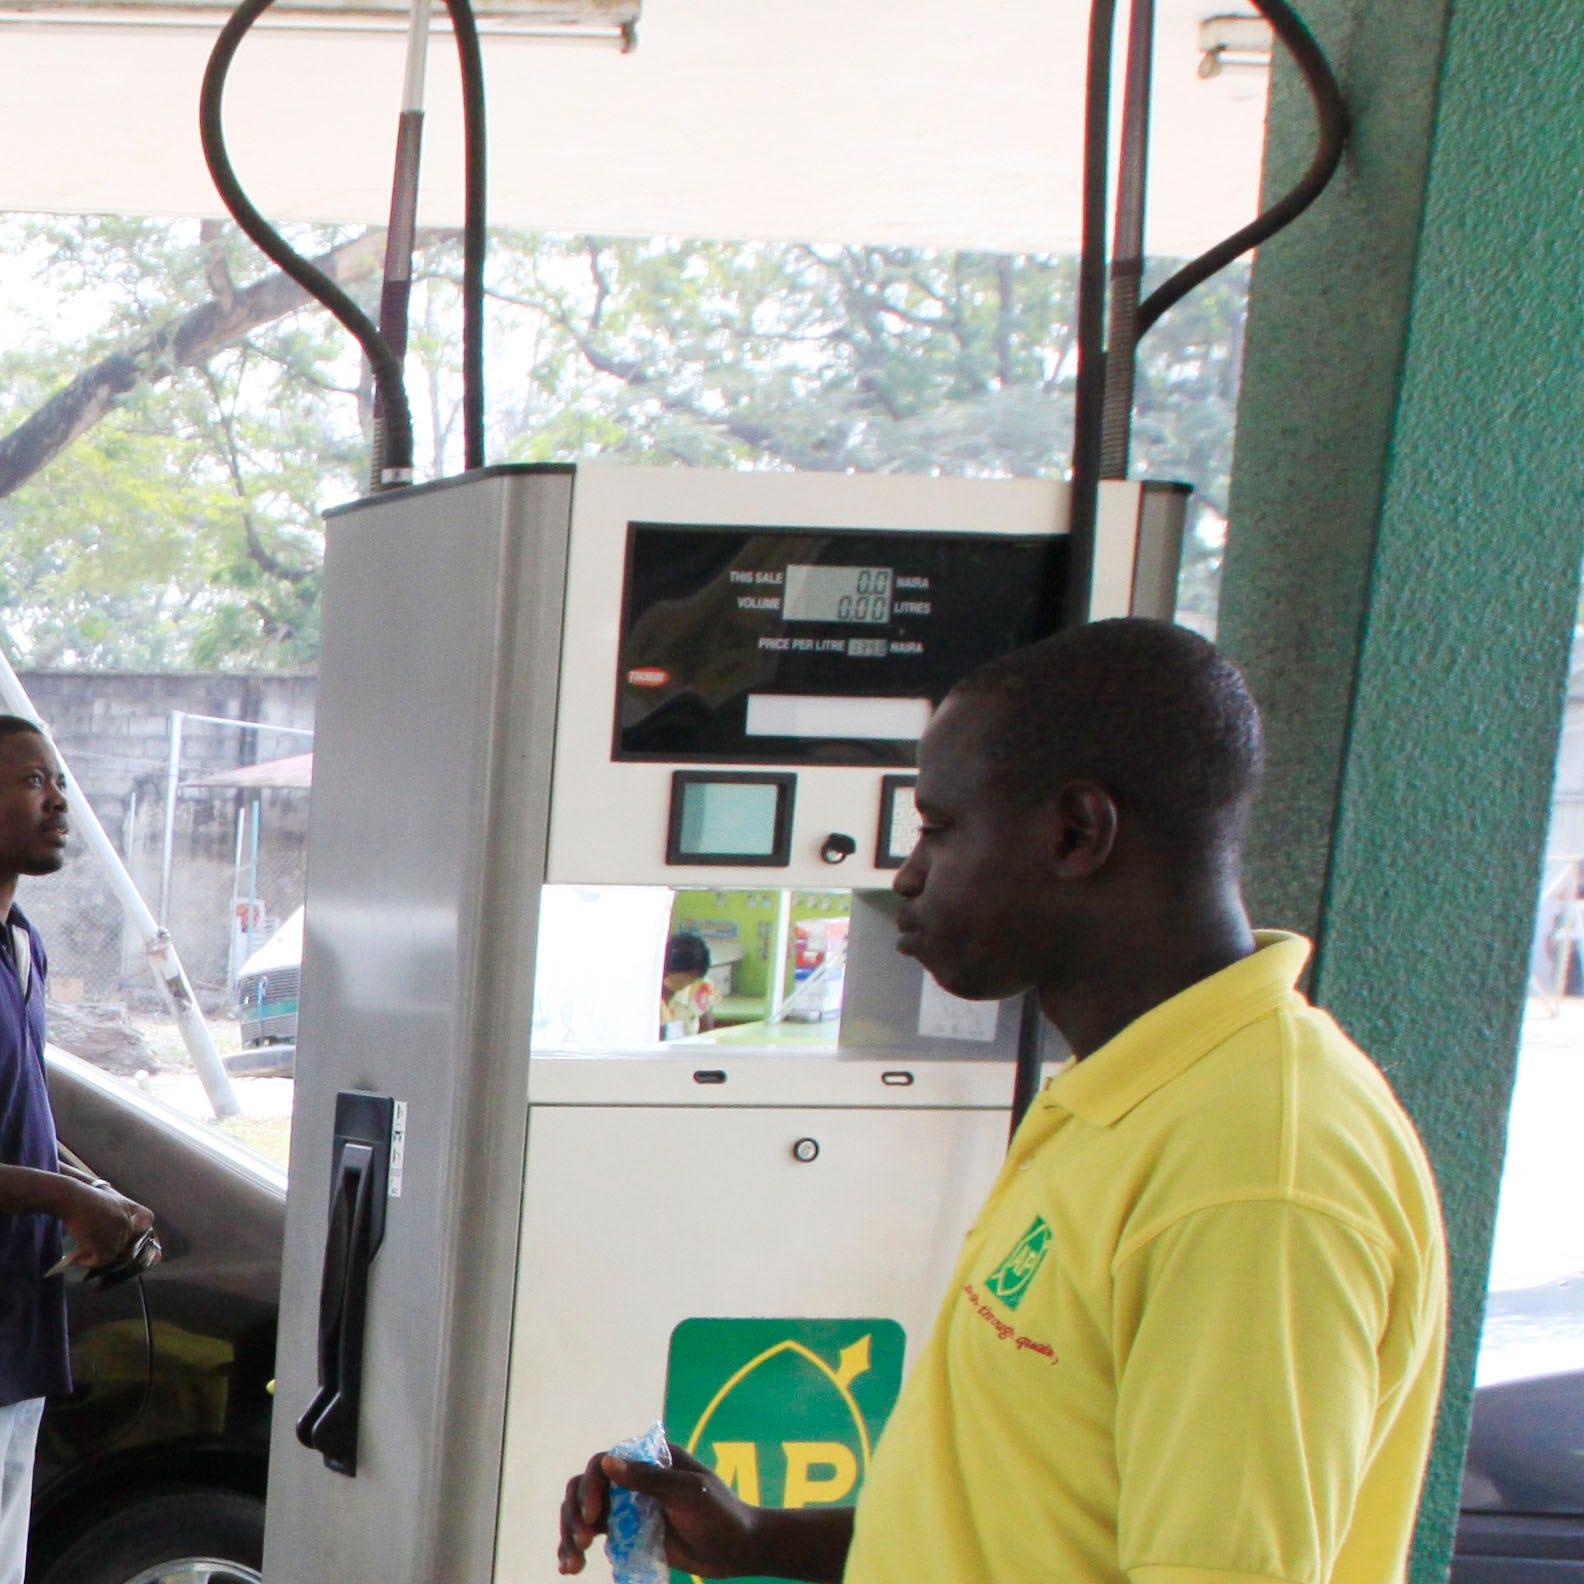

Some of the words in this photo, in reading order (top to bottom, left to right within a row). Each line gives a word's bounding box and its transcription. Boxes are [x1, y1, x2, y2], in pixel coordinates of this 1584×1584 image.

[730, 571, 753, 584] THIS
[755, 572, 784, 585] SALE
[895, 577, 930, 590] NAIRA
[737, 596, 781, 610] VOLUME
[894, 601, 931, 614] LITRES
[758, 637, 790, 650] PRICE
[792, 638, 813, 650] PER
[815, 639, 846, 652] LITRE
[890, 641, 924, 654] NAIRA
